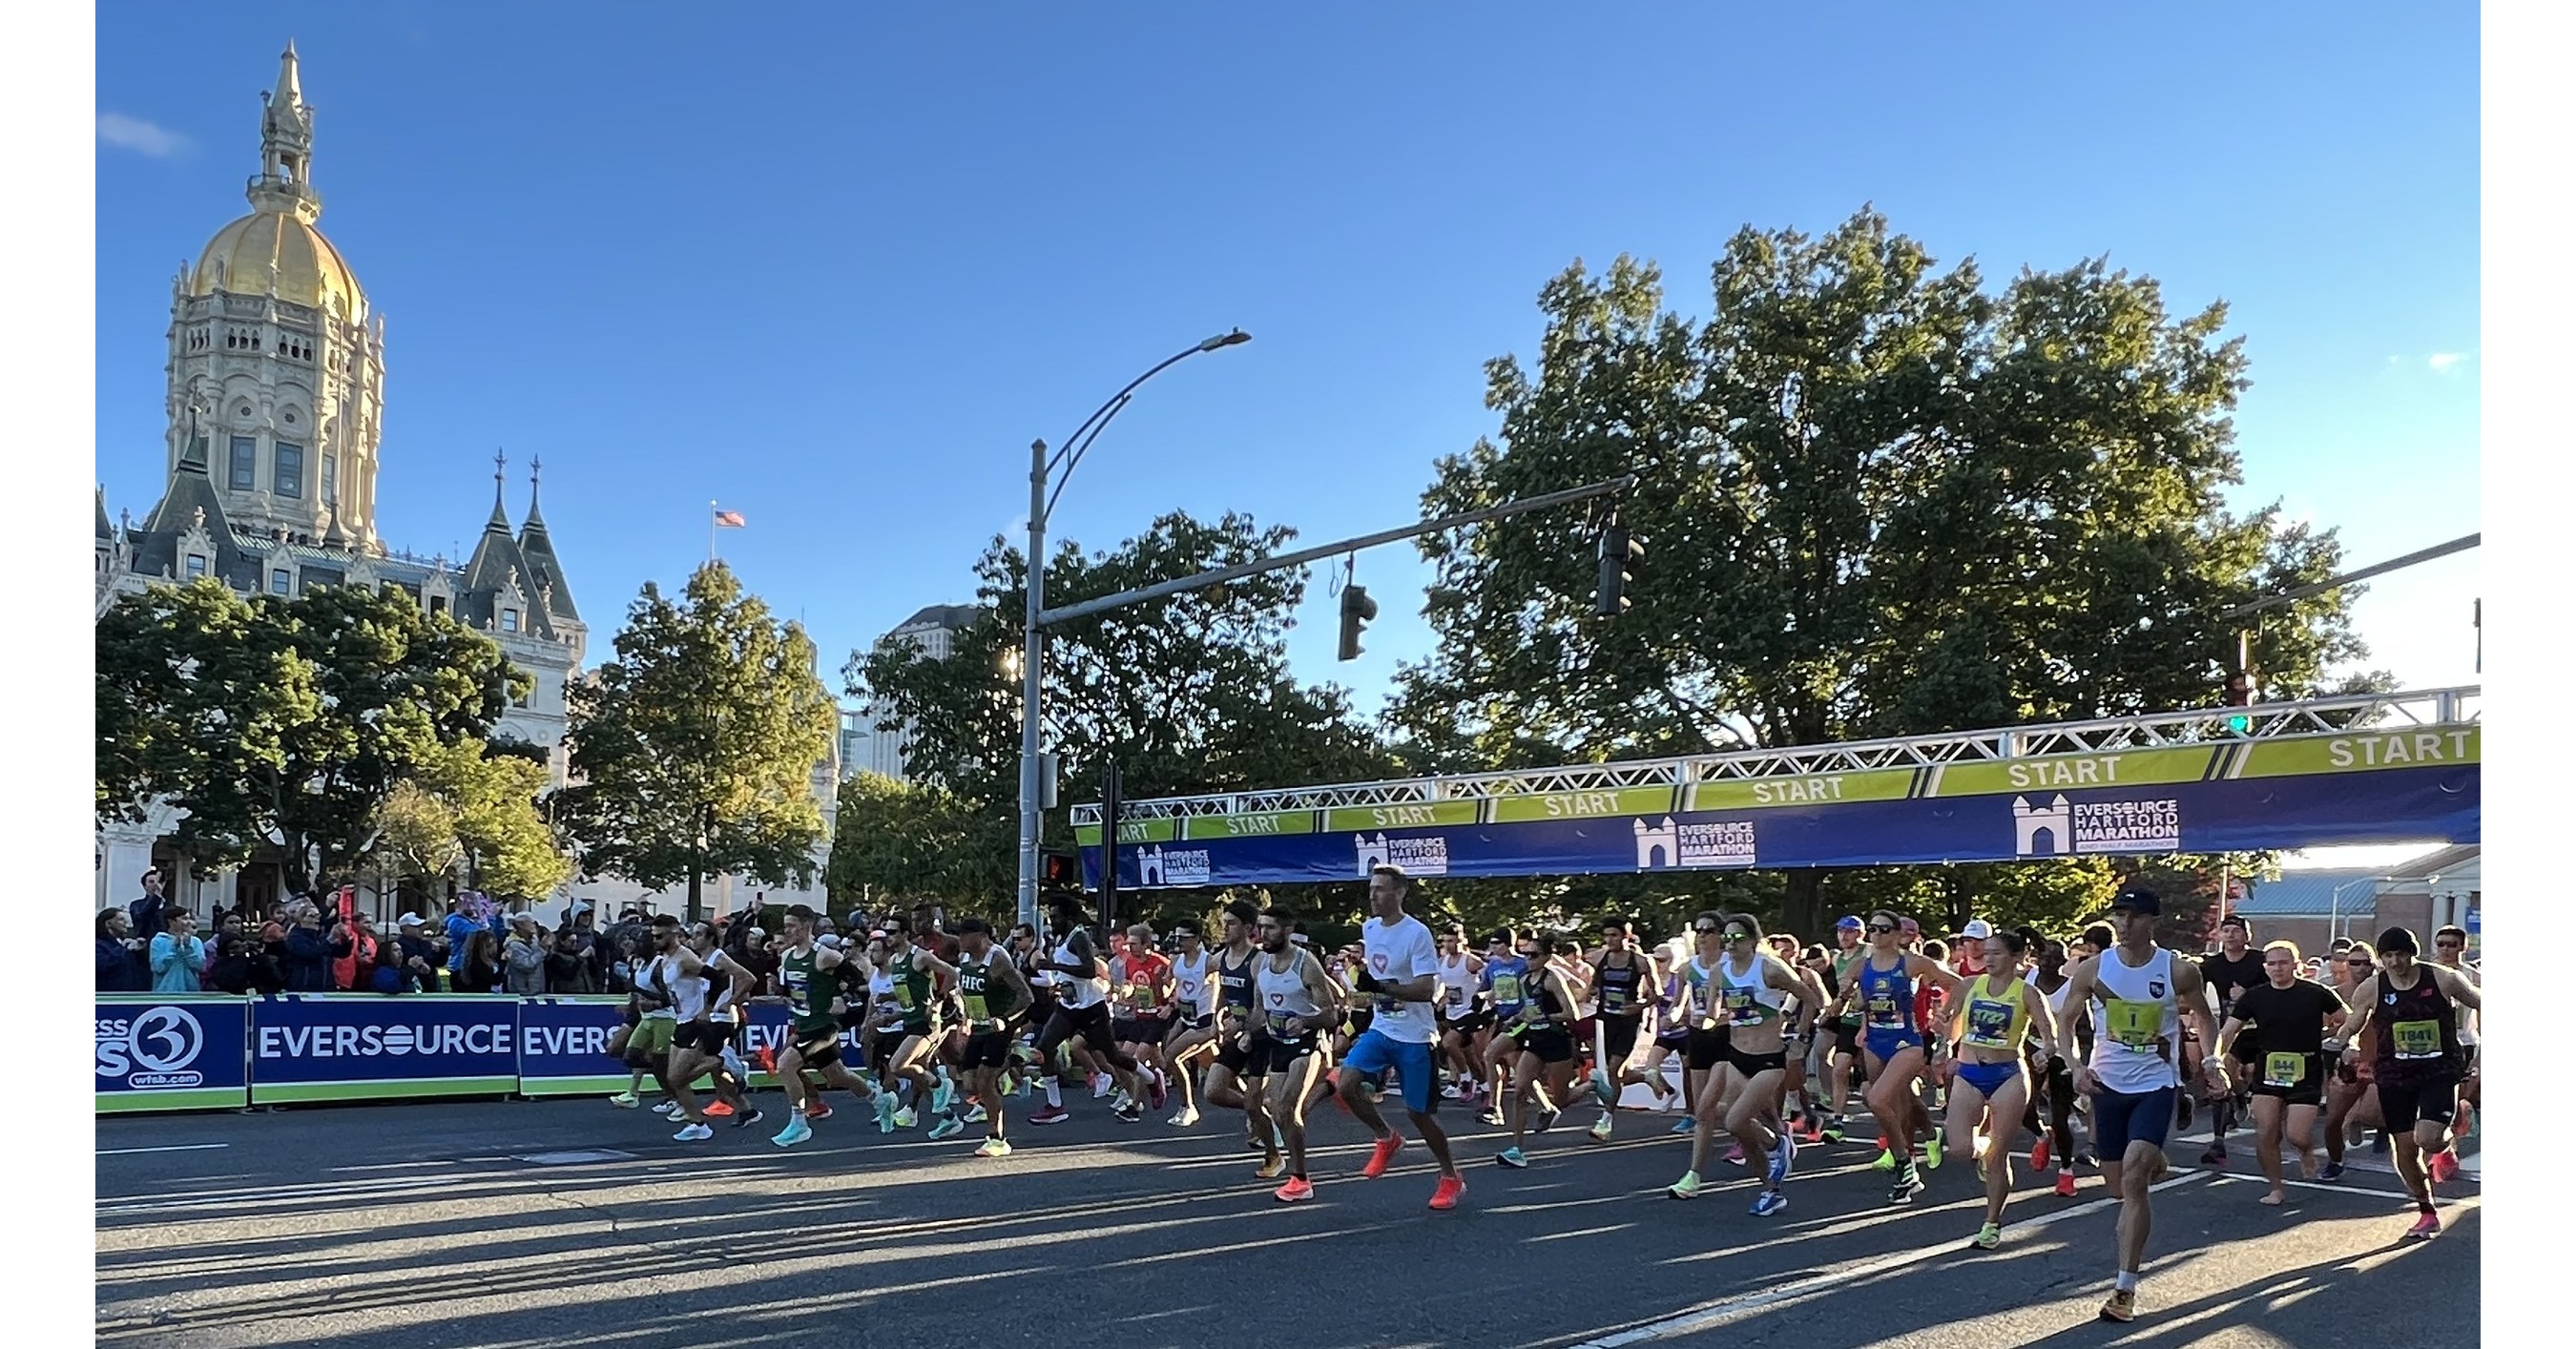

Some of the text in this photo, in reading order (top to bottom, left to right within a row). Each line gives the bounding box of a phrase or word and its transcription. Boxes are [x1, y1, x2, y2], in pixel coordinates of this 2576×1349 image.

[2329, 730, 2471, 766] START
[2008, 756, 2122, 787] START
[1753, 777, 1844, 803] START
[1544, 792, 1620, 816] START
[2074, 799, 2178, 817] EVERSOURCE
[1226, 815, 1280, 834] START
[1372, 806, 1438, 825] START
[2075, 812, 2178, 828] HARTFORD
[1116, 823, 1149, 841] ART
[1678, 821, 1754, 836] EVERSOURCE
[2076, 824, 2179, 841] MARATHON
[1679, 833, 1755, 845] HARTFORD
[1390, 846, 1446, 858] HARTFORD
[1680, 843, 1755, 857] MARATHON
[1390, 855, 1447, 865] MARATHON
[260, 1024, 511, 1058] EVERSOURCE
